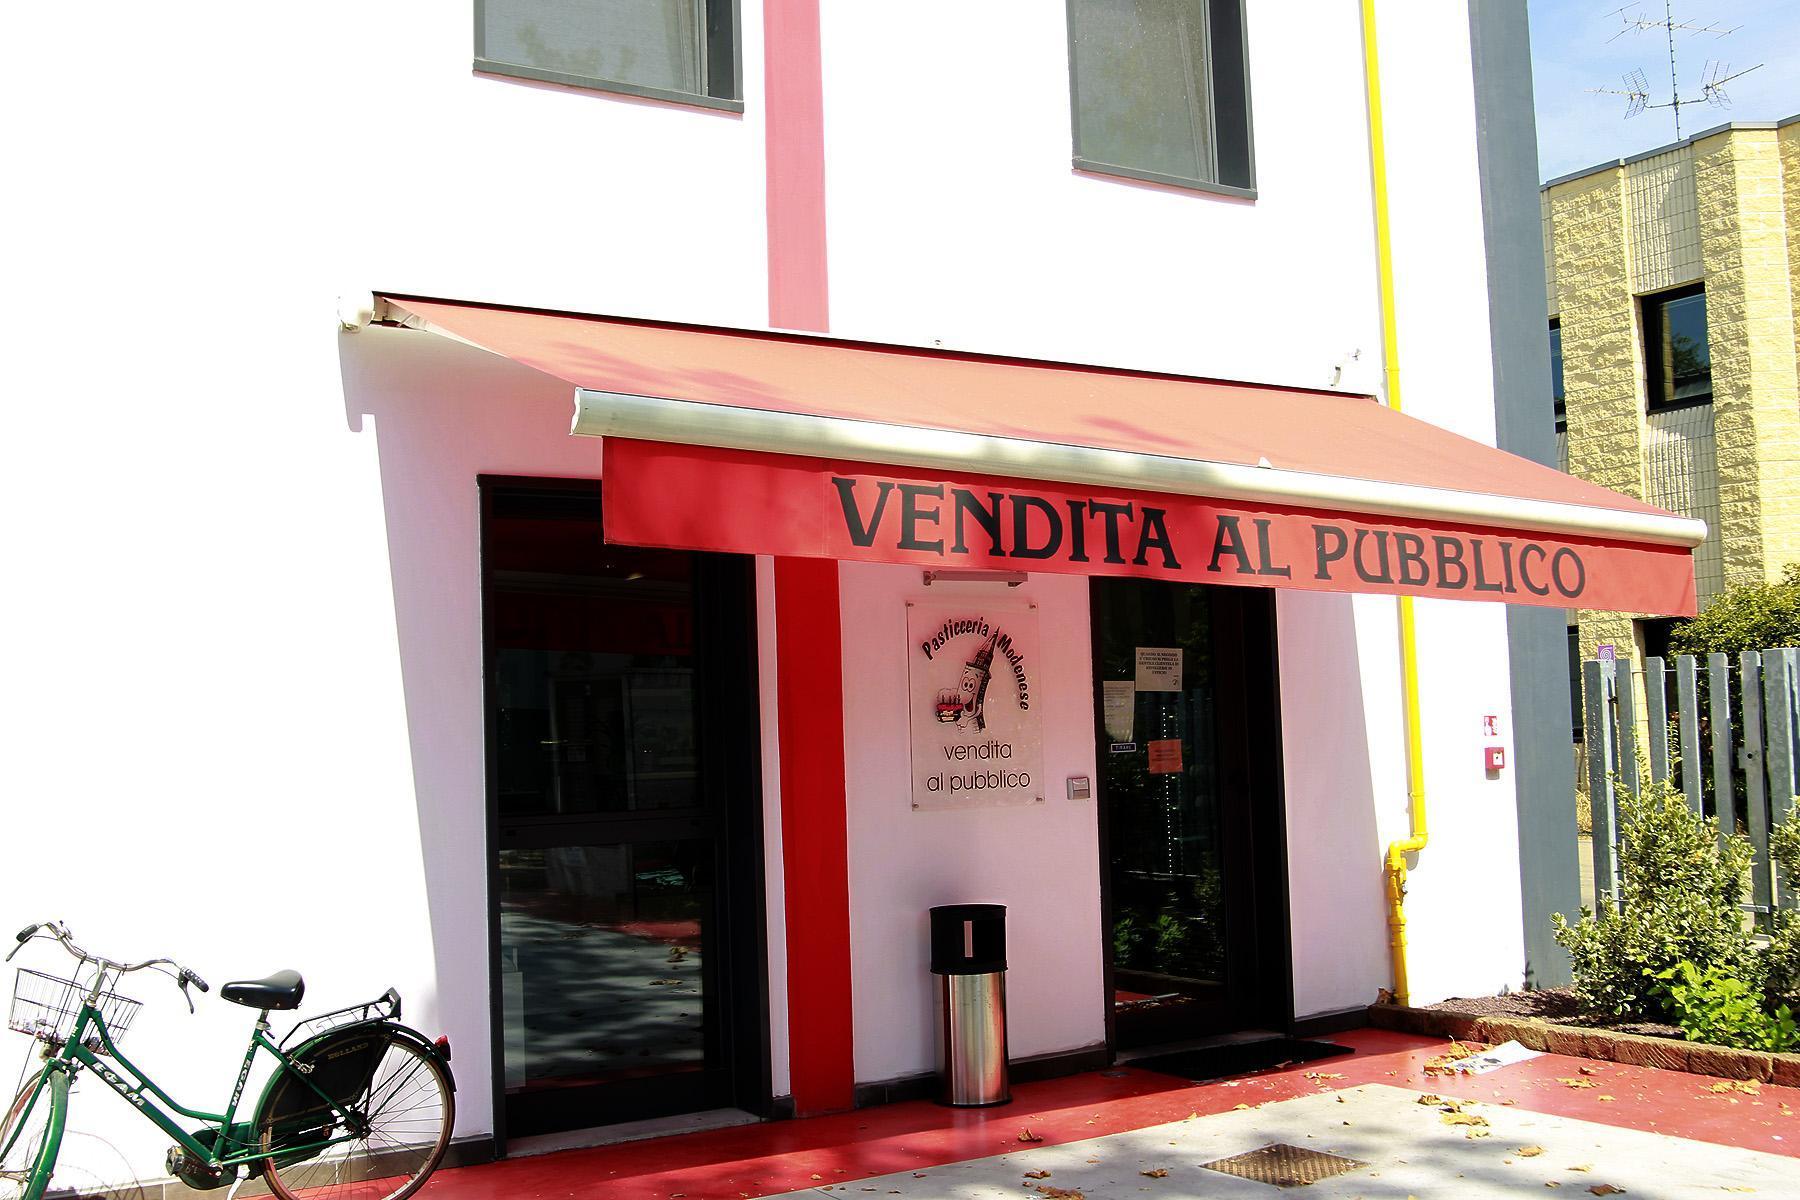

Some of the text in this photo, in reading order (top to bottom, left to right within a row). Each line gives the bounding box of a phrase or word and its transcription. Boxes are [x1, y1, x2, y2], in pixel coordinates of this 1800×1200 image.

[832, 476, 1586, 599] VENDITA AL PUBBLICO
[921, 616, 1030, 711] Pasticceria Modenese
[943, 740, 1012, 761] vendita
[926, 769, 1031, 795] al pubblico
